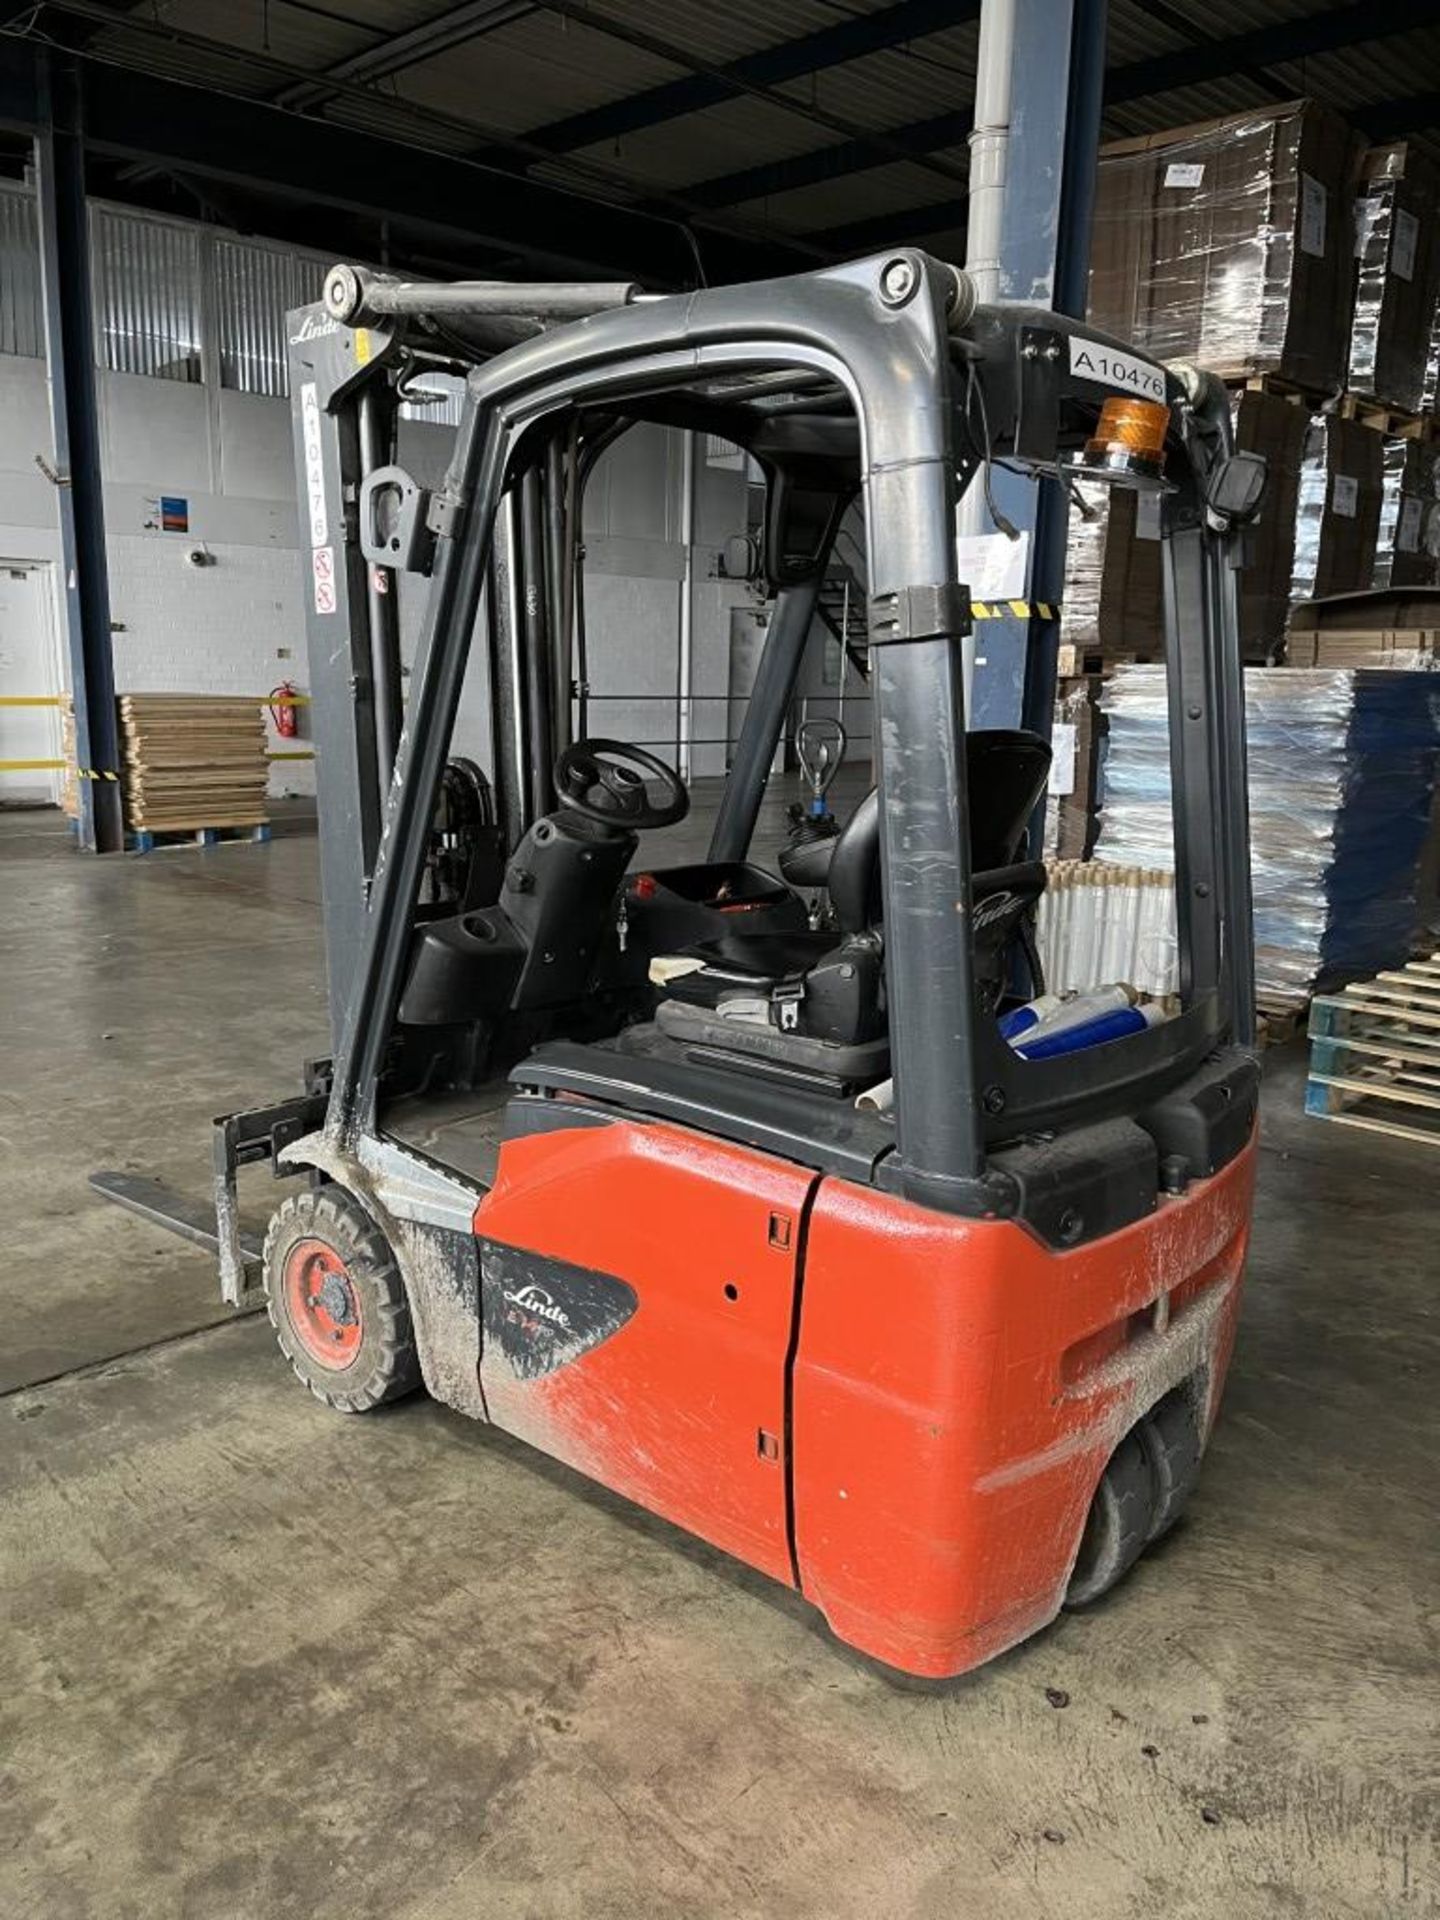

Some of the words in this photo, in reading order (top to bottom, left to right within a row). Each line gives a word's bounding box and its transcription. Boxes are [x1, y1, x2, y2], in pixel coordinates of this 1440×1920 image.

[1075, 352, 1163, 396] A10476
[305, 392, 324, 538] A10476
[503, 1285, 572, 1328] Linde
